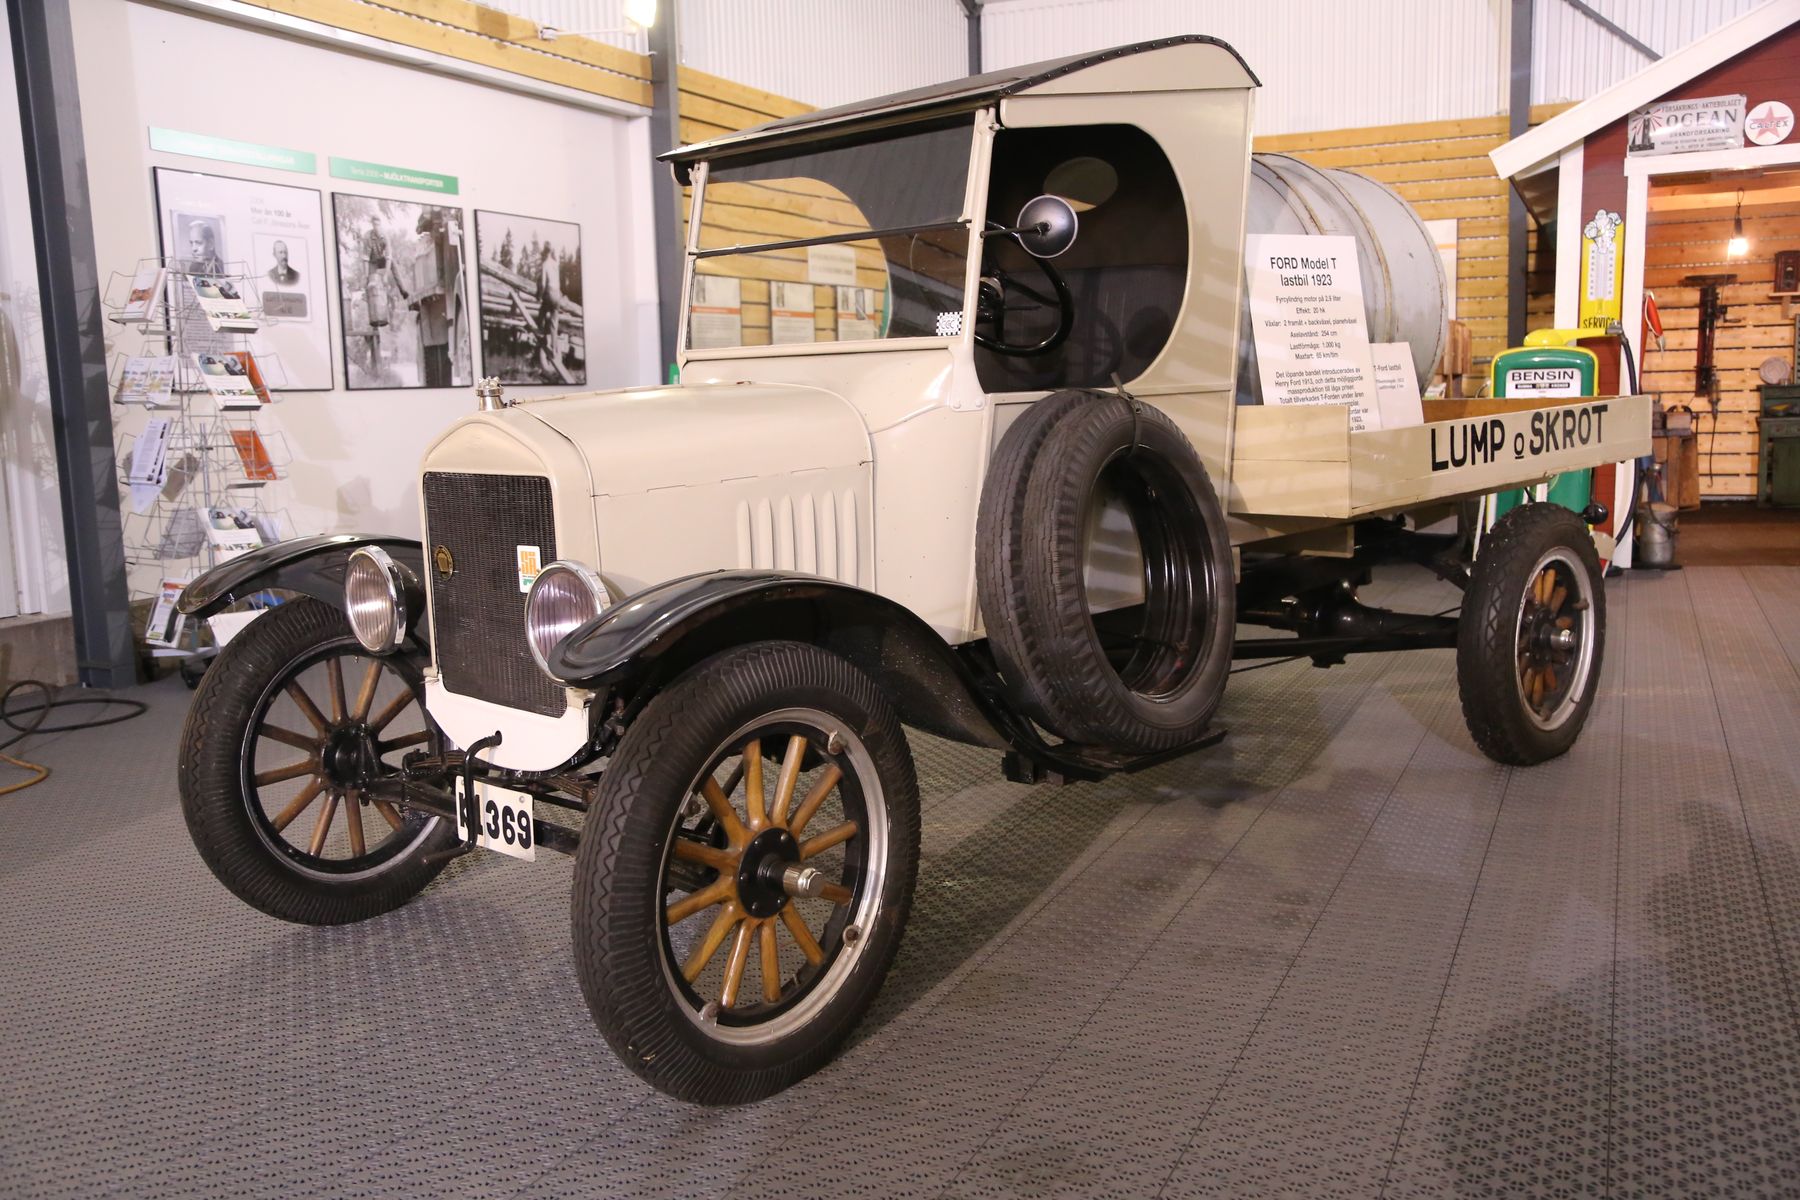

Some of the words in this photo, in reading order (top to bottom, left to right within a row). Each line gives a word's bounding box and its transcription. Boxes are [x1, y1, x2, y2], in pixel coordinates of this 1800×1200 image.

[1750, 120, 1788, 130] CALTEX
[1270, 257, 1298, 269] FORD
[1301, 257, 1329, 270] Model
[1331, 258, 1337, 269] T
[1280, 274, 1309, 286] lastbil
[1311, 274, 1332, 286] 1923
[1512, 370, 1574, 381] BENSIN
[1275, 379, 1289, 387] Henry
[1431, 419, 1505, 472] LUMP
[1529, 404, 1608, 456] SKROT
